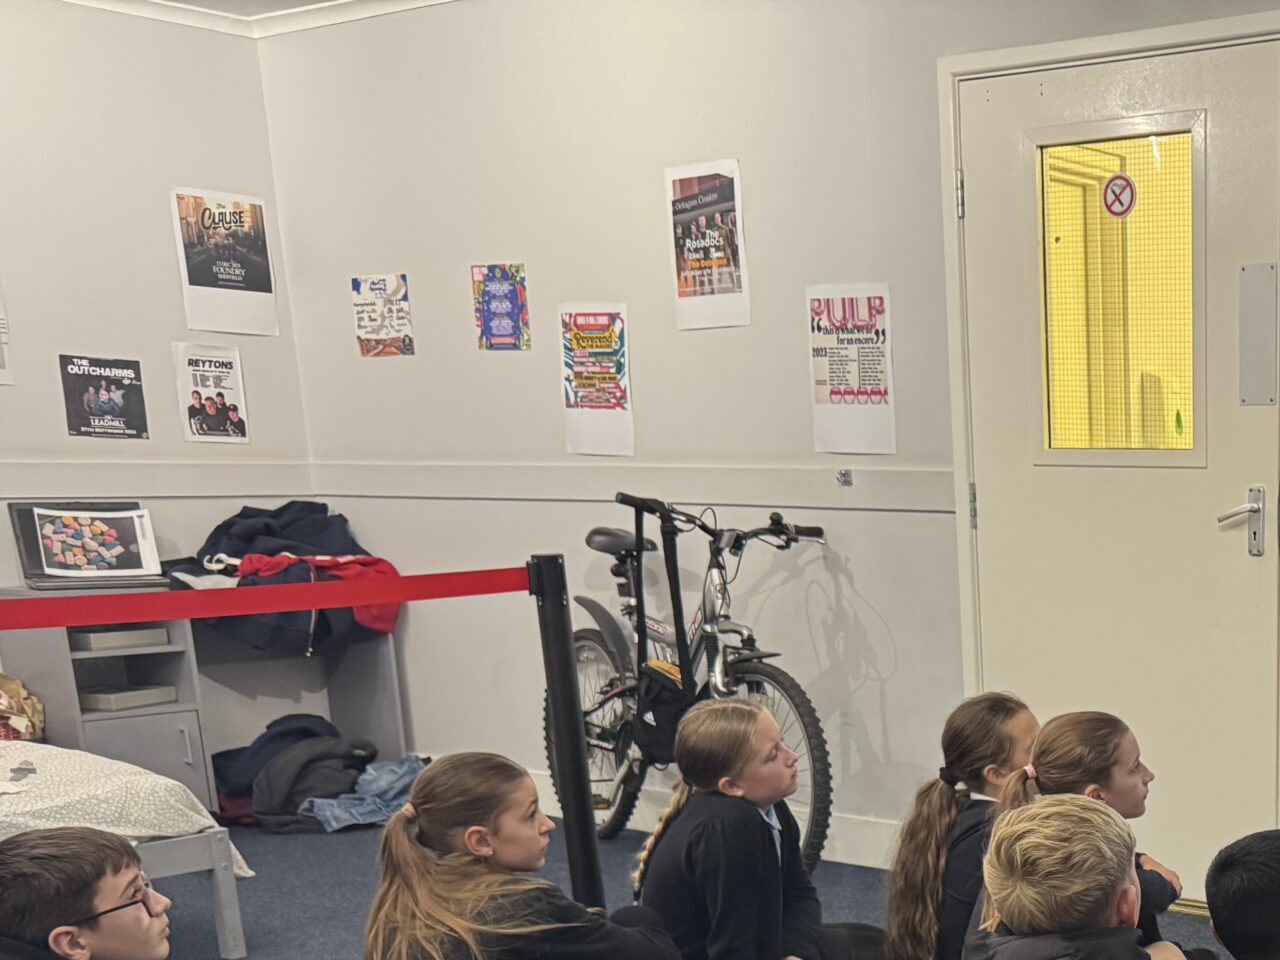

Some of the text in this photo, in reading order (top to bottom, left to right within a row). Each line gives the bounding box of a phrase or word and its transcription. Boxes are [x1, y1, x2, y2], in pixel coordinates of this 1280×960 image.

[201, 207, 245, 231] CLAUSE
[685, 237, 724, 251] Rosadocs
[212, 265, 246, 276] FOUNDRY
[810, 296, 885, 330] PULP
[72, 358, 90, 366] THE
[187, 358, 234, 370] REYTONS
[67, 364, 135, 379] OUTCHARMS
